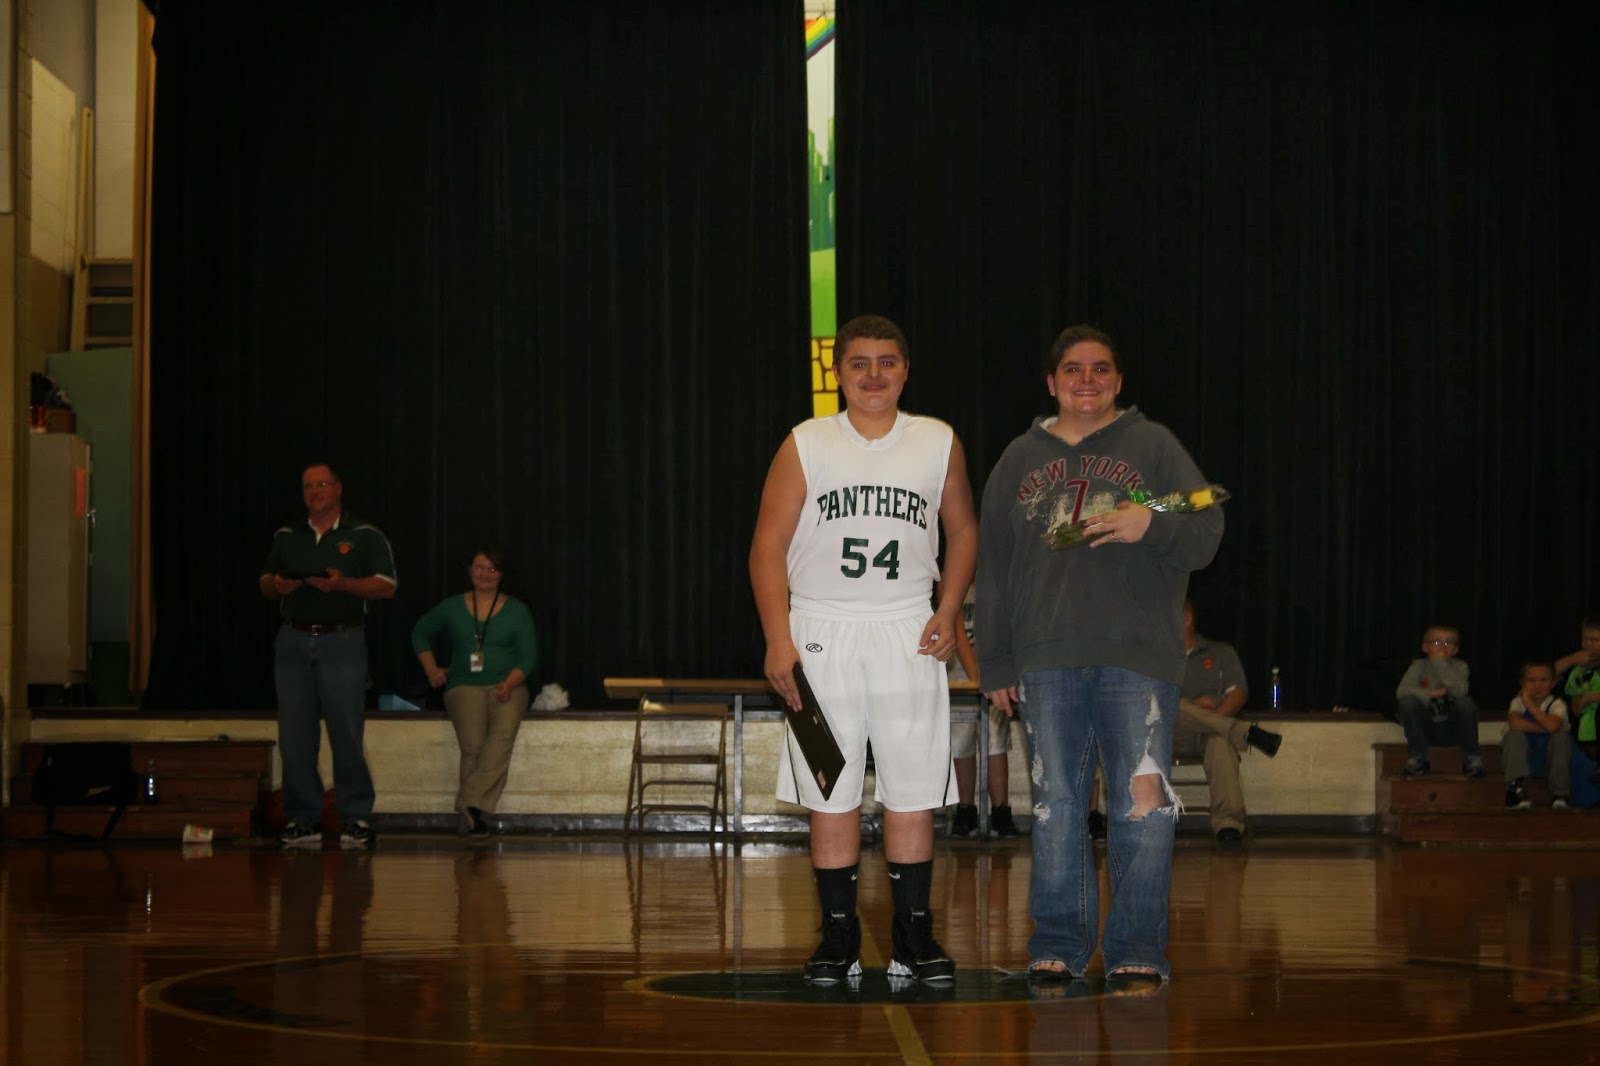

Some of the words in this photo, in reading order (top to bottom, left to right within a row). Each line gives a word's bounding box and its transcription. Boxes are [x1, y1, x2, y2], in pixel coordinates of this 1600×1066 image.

[1017, 458, 1067, 502] NEW
[1079, 456, 1144, 492] YORK
[1064, 478, 1089, 525] 7
[817, 485, 928, 530] PANTHERS
[841, 537, 900, 580] 54
